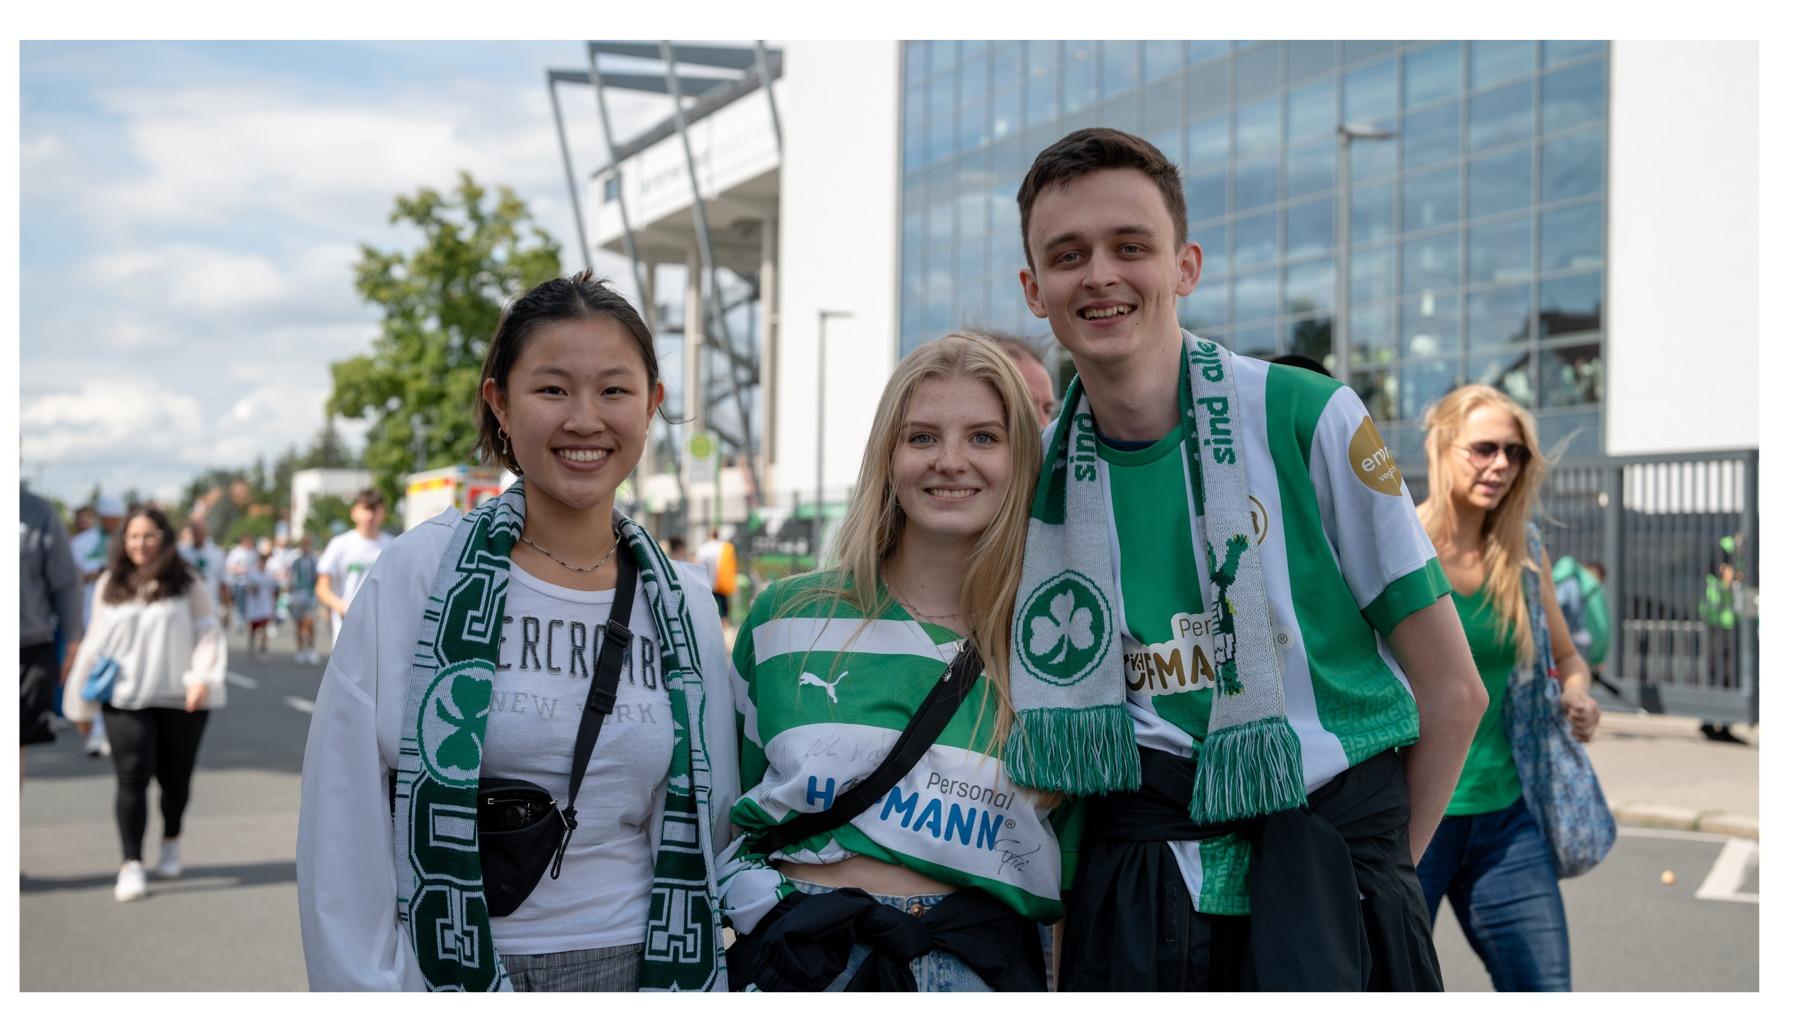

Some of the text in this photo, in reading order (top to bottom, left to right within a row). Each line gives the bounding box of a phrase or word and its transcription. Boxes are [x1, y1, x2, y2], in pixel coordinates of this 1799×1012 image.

[1069, 413, 1097, 482] sind
[1197, 396, 1237, 465] sind
[489, 691, 559, 719] NEW
[806, 775, 1004, 851] HMANN
[926, 771, 1016, 811] Personal
